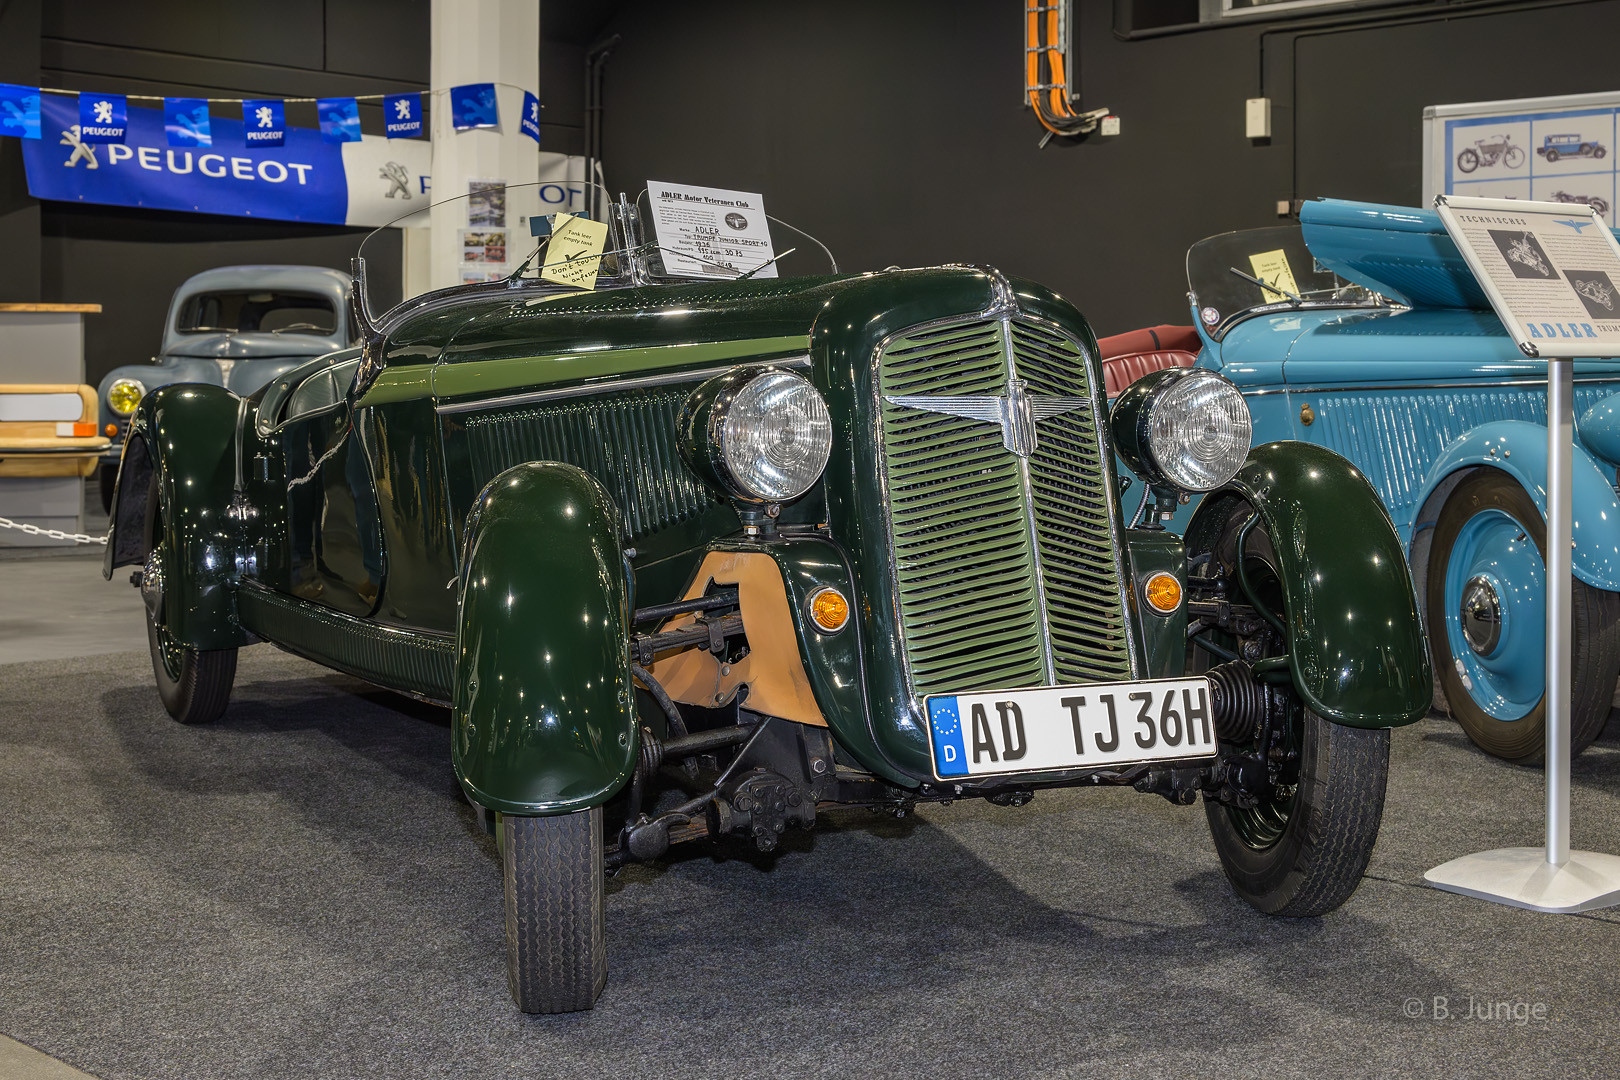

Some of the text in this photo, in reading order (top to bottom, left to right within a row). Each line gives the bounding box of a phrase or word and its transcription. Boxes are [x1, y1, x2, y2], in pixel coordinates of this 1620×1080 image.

[82, 126, 124, 137] PEUGEOT
[388, 121, 420, 132] PEUGEOT
[247, 131, 283, 140] PEUGEOT
[108, 144, 313, 185] PEUGEOT
[661, 191, 682, 200] ADLER
[684, 194, 703, 203] Motor
[704, 197, 735, 206] Veteranen
[735, 200, 749, 208] Club
[1460, 215, 1527, 226] TECHNISCHES
[695, 226, 720, 235] ADLER
[563, 236, 580, 244] empty
[741, 239, 759, 247] SPORT
[551, 263, 574, 275] Don't
[1526, 322, 1598, 338] ADLER
[970, 687, 1211, 763] AD TJ 36H
[943, 745, 956, 763] D
